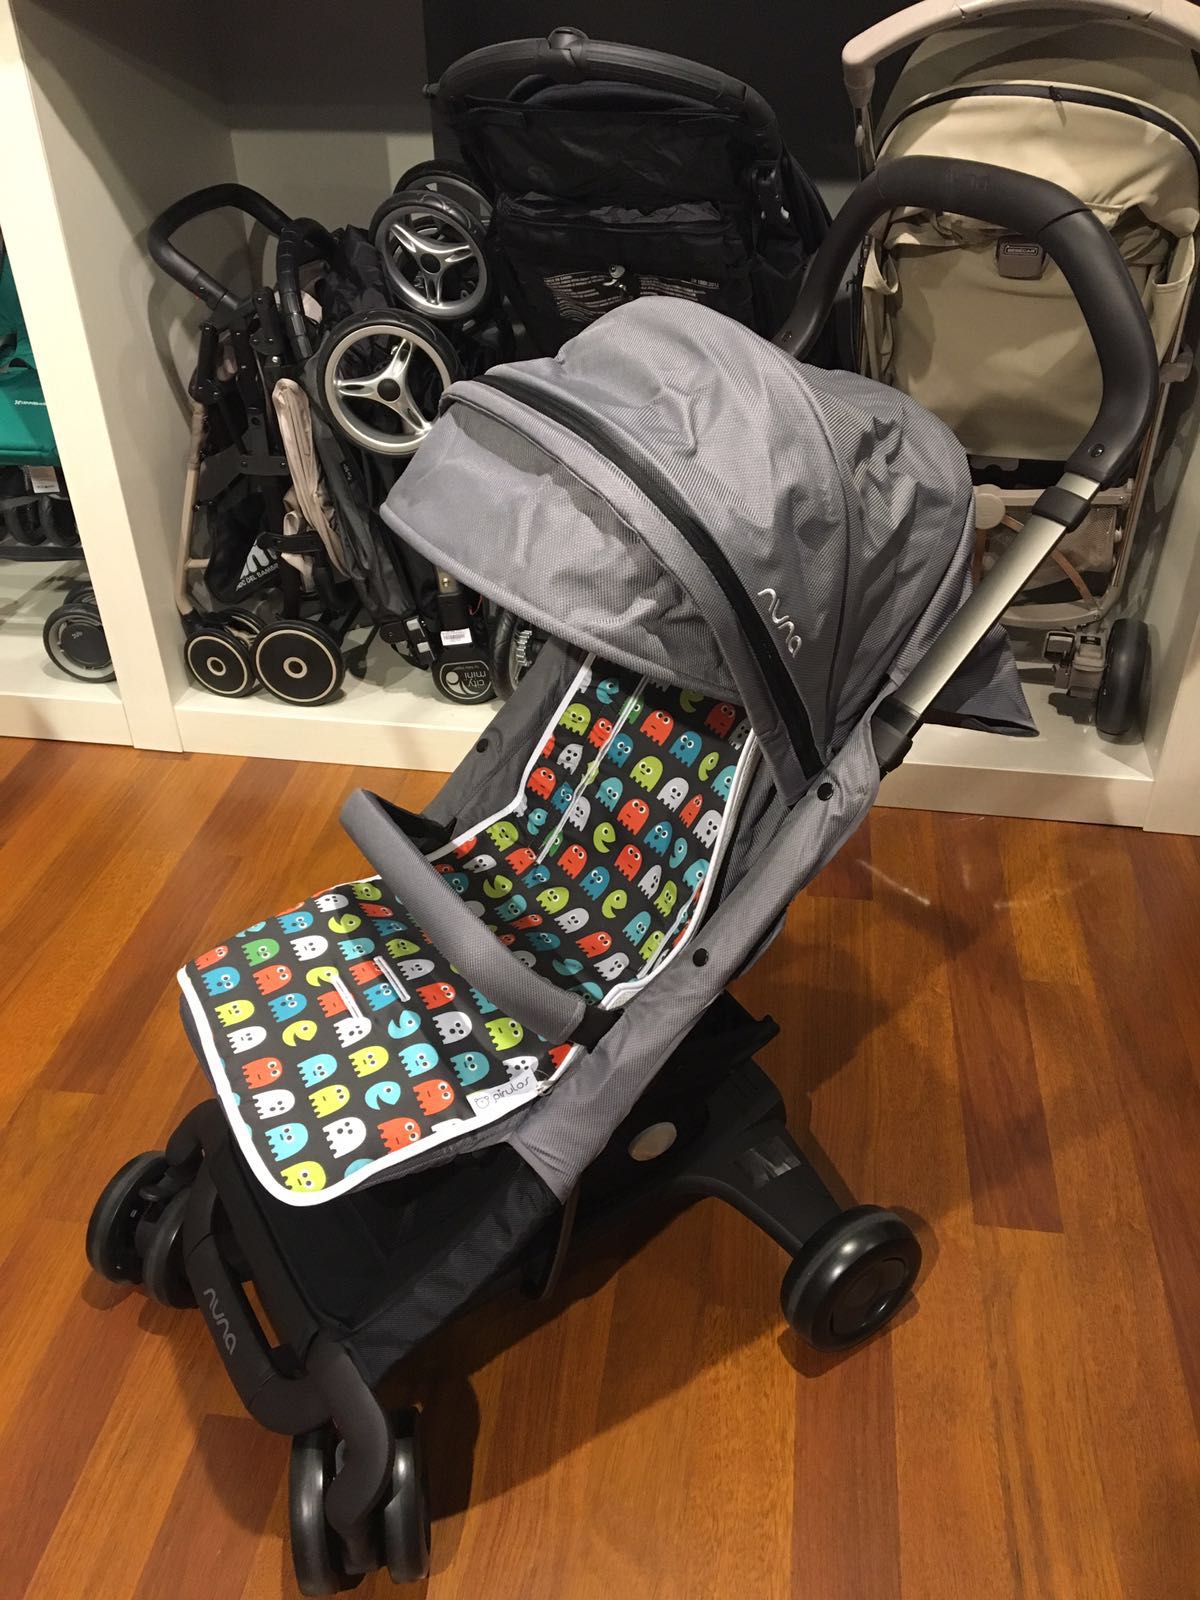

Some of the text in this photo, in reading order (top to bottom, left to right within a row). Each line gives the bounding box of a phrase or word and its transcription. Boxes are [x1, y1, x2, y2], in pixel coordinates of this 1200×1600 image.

[757, 588, 802, 658] nuna
[464, 670, 487, 681] mini
[468, 678, 485, 688] city
[492, 1076, 531, 1103] pirulos
[203, 1288, 237, 1355] nuna
